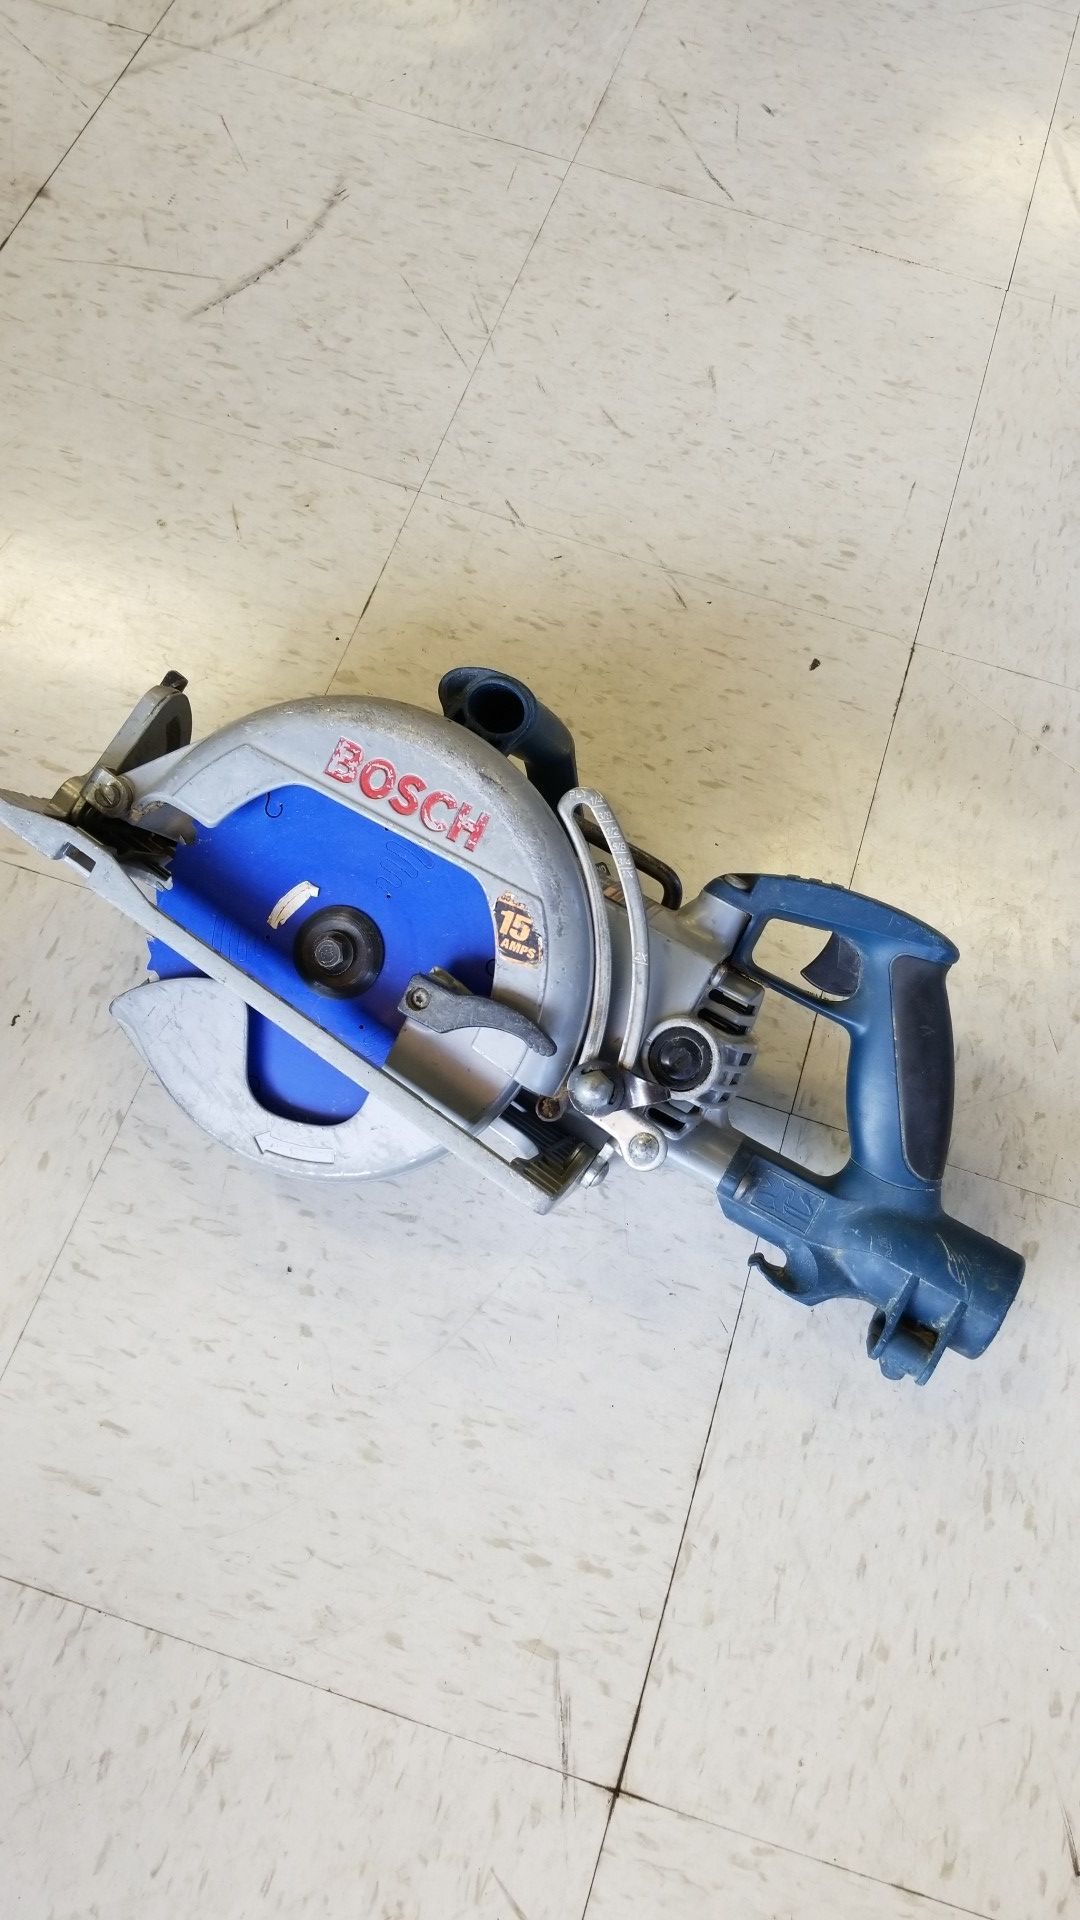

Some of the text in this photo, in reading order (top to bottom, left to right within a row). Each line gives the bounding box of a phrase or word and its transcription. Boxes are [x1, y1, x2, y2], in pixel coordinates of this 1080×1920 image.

[324, 736, 491, 852] BOSCH
[500, 910, 533, 942] 15
[500, 938, 537, 959] AMPS
